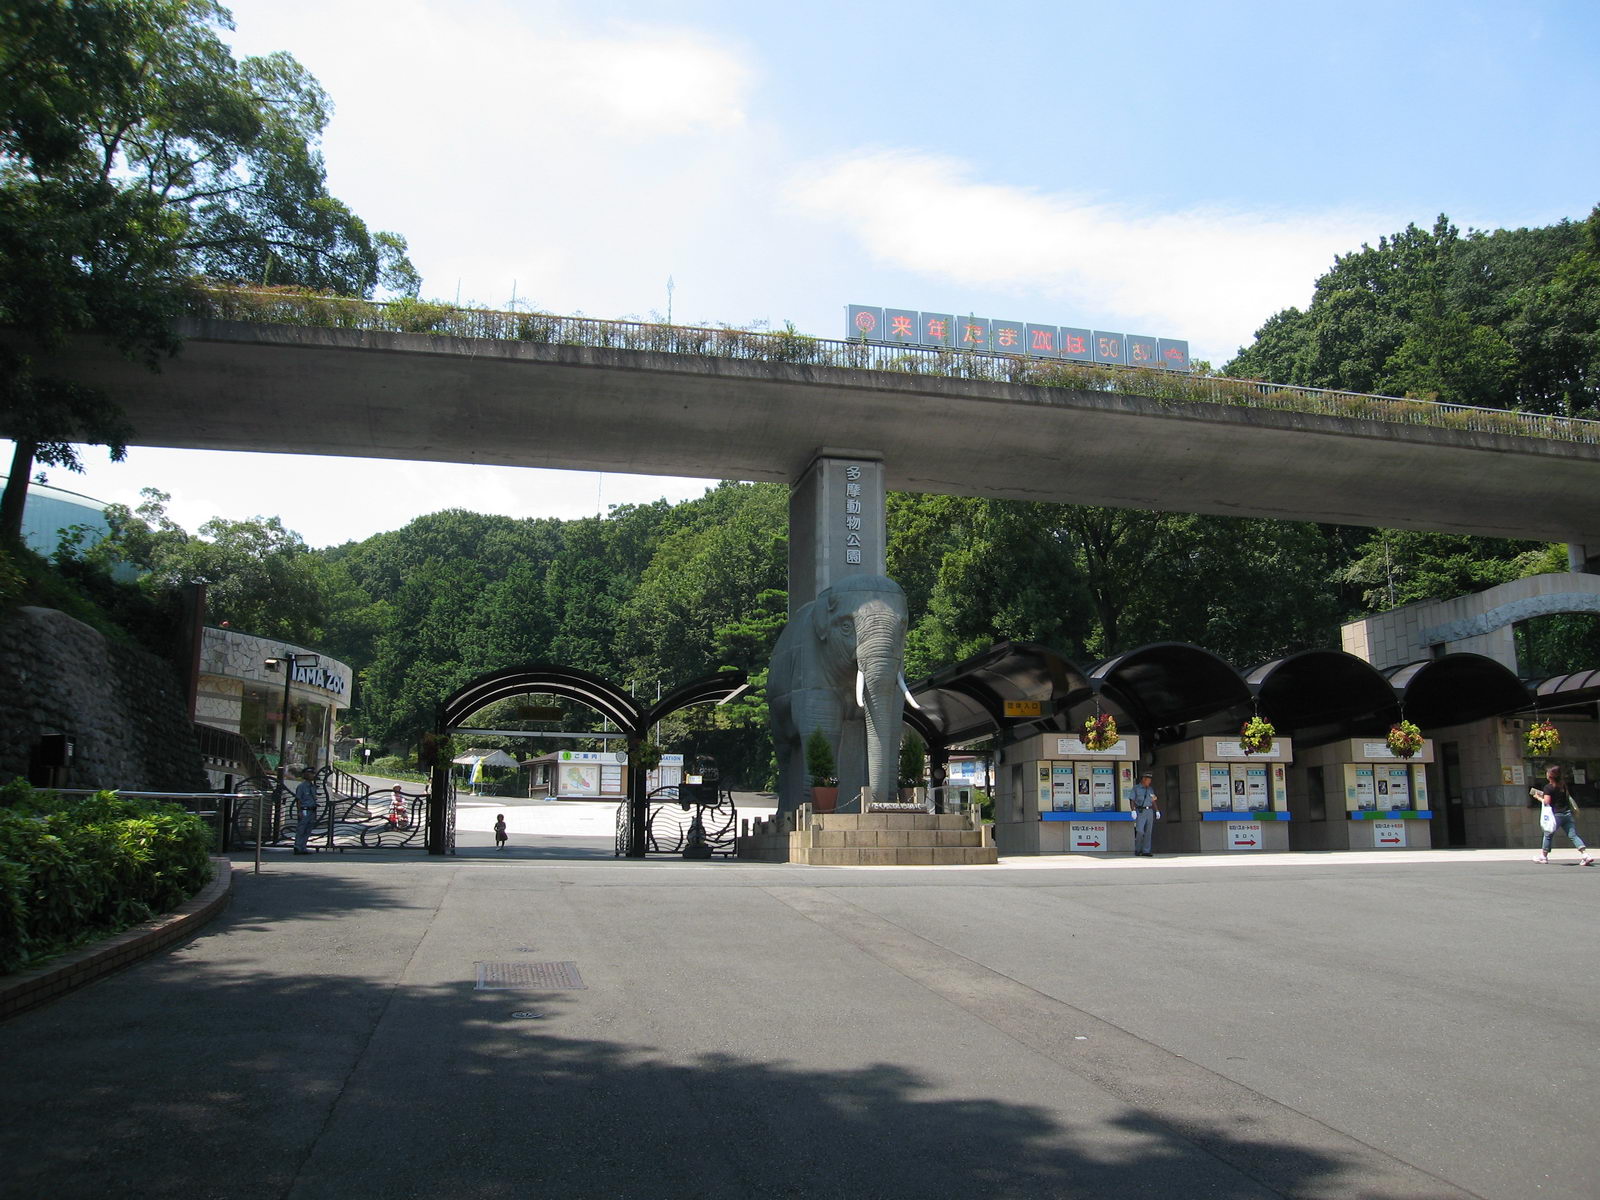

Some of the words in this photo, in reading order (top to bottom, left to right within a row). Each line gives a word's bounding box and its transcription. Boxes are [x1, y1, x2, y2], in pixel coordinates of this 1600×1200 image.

[846, 465, 861, 564] 多摩動物公園
[326, 669, 345, 694] ZOO
